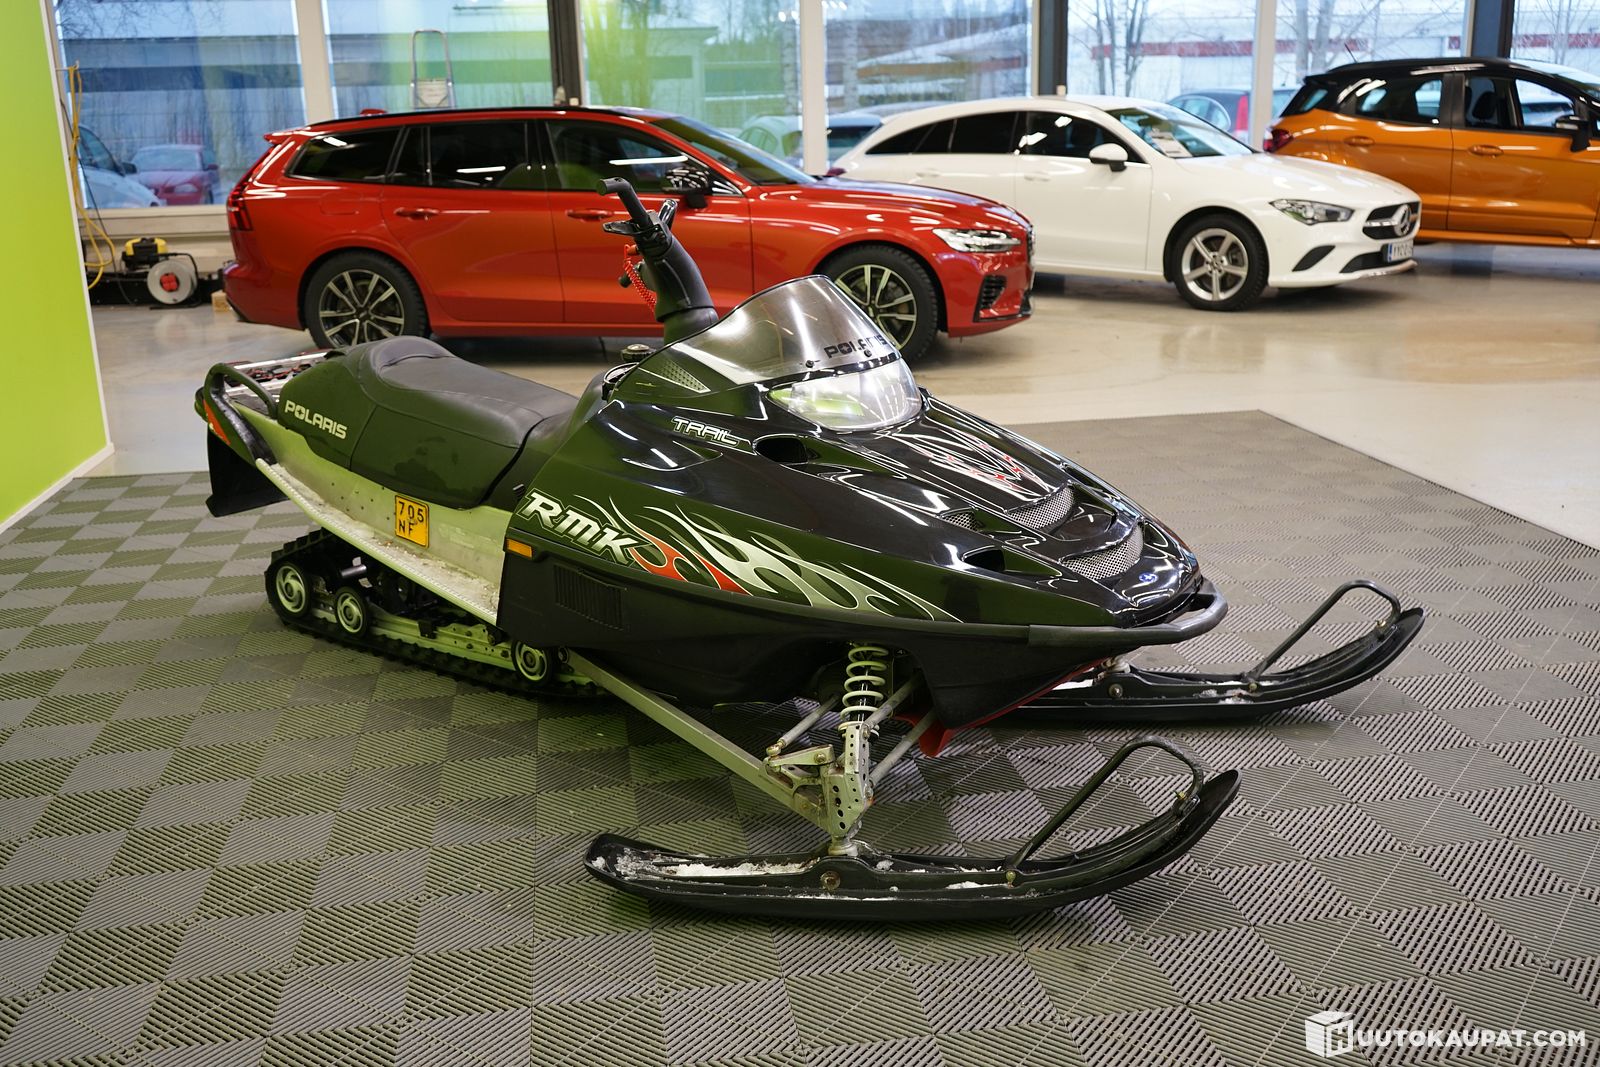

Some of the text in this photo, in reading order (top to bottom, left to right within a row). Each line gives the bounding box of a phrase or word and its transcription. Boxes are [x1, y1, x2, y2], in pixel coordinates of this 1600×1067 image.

[284, 400, 348, 440] POLARIS
[671, 417, 738, 446] TRAIL
[398, 500, 424, 523] 705
[398, 518, 416, 536] NF
[518, 489, 641, 566] RMK
